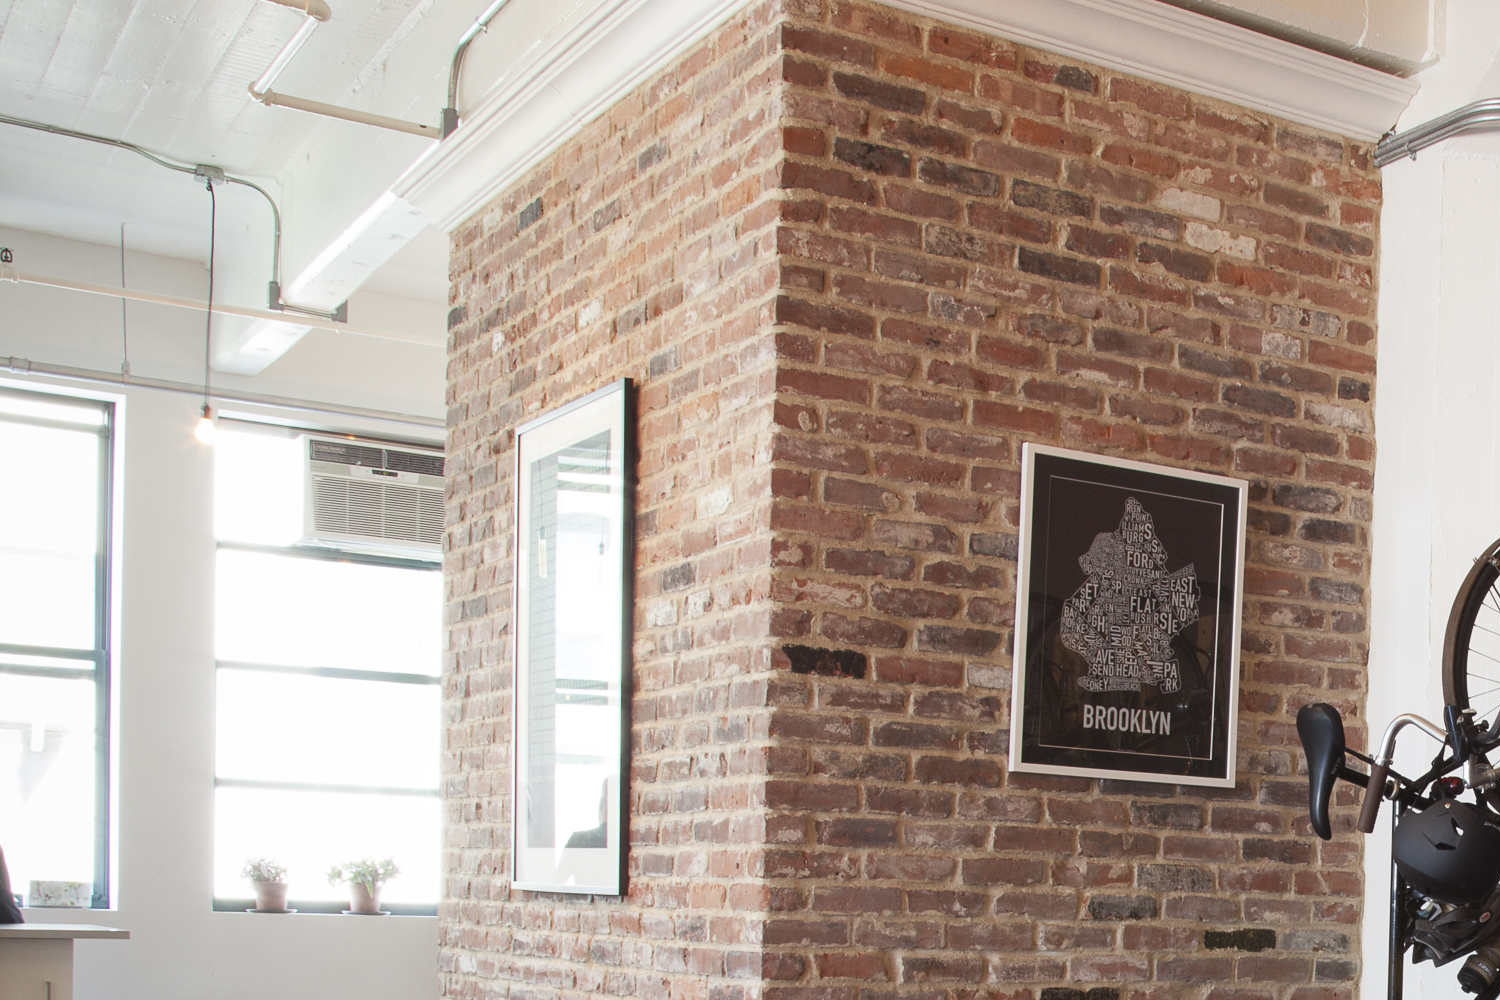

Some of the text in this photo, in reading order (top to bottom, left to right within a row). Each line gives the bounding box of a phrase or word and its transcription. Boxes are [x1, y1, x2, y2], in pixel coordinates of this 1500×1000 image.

[1127, 551, 1154, 569] FORD
[1080, 583, 1099, 599] SET
[1133, 588, 1152, 597] EAST
[1170, 576, 1195, 593] EAST
[1130, 596, 1157, 614] FLAT
[1172, 592, 1195, 609] NEW
[1131, 612, 1151, 624] BUSH
[1092, 663, 1114, 677] SEND
[1116, 664, 1139, 677] HEAD
[1086, 678, 1109, 691] CONEY
[1083, 704, 1171, 736] BROOKLYN
